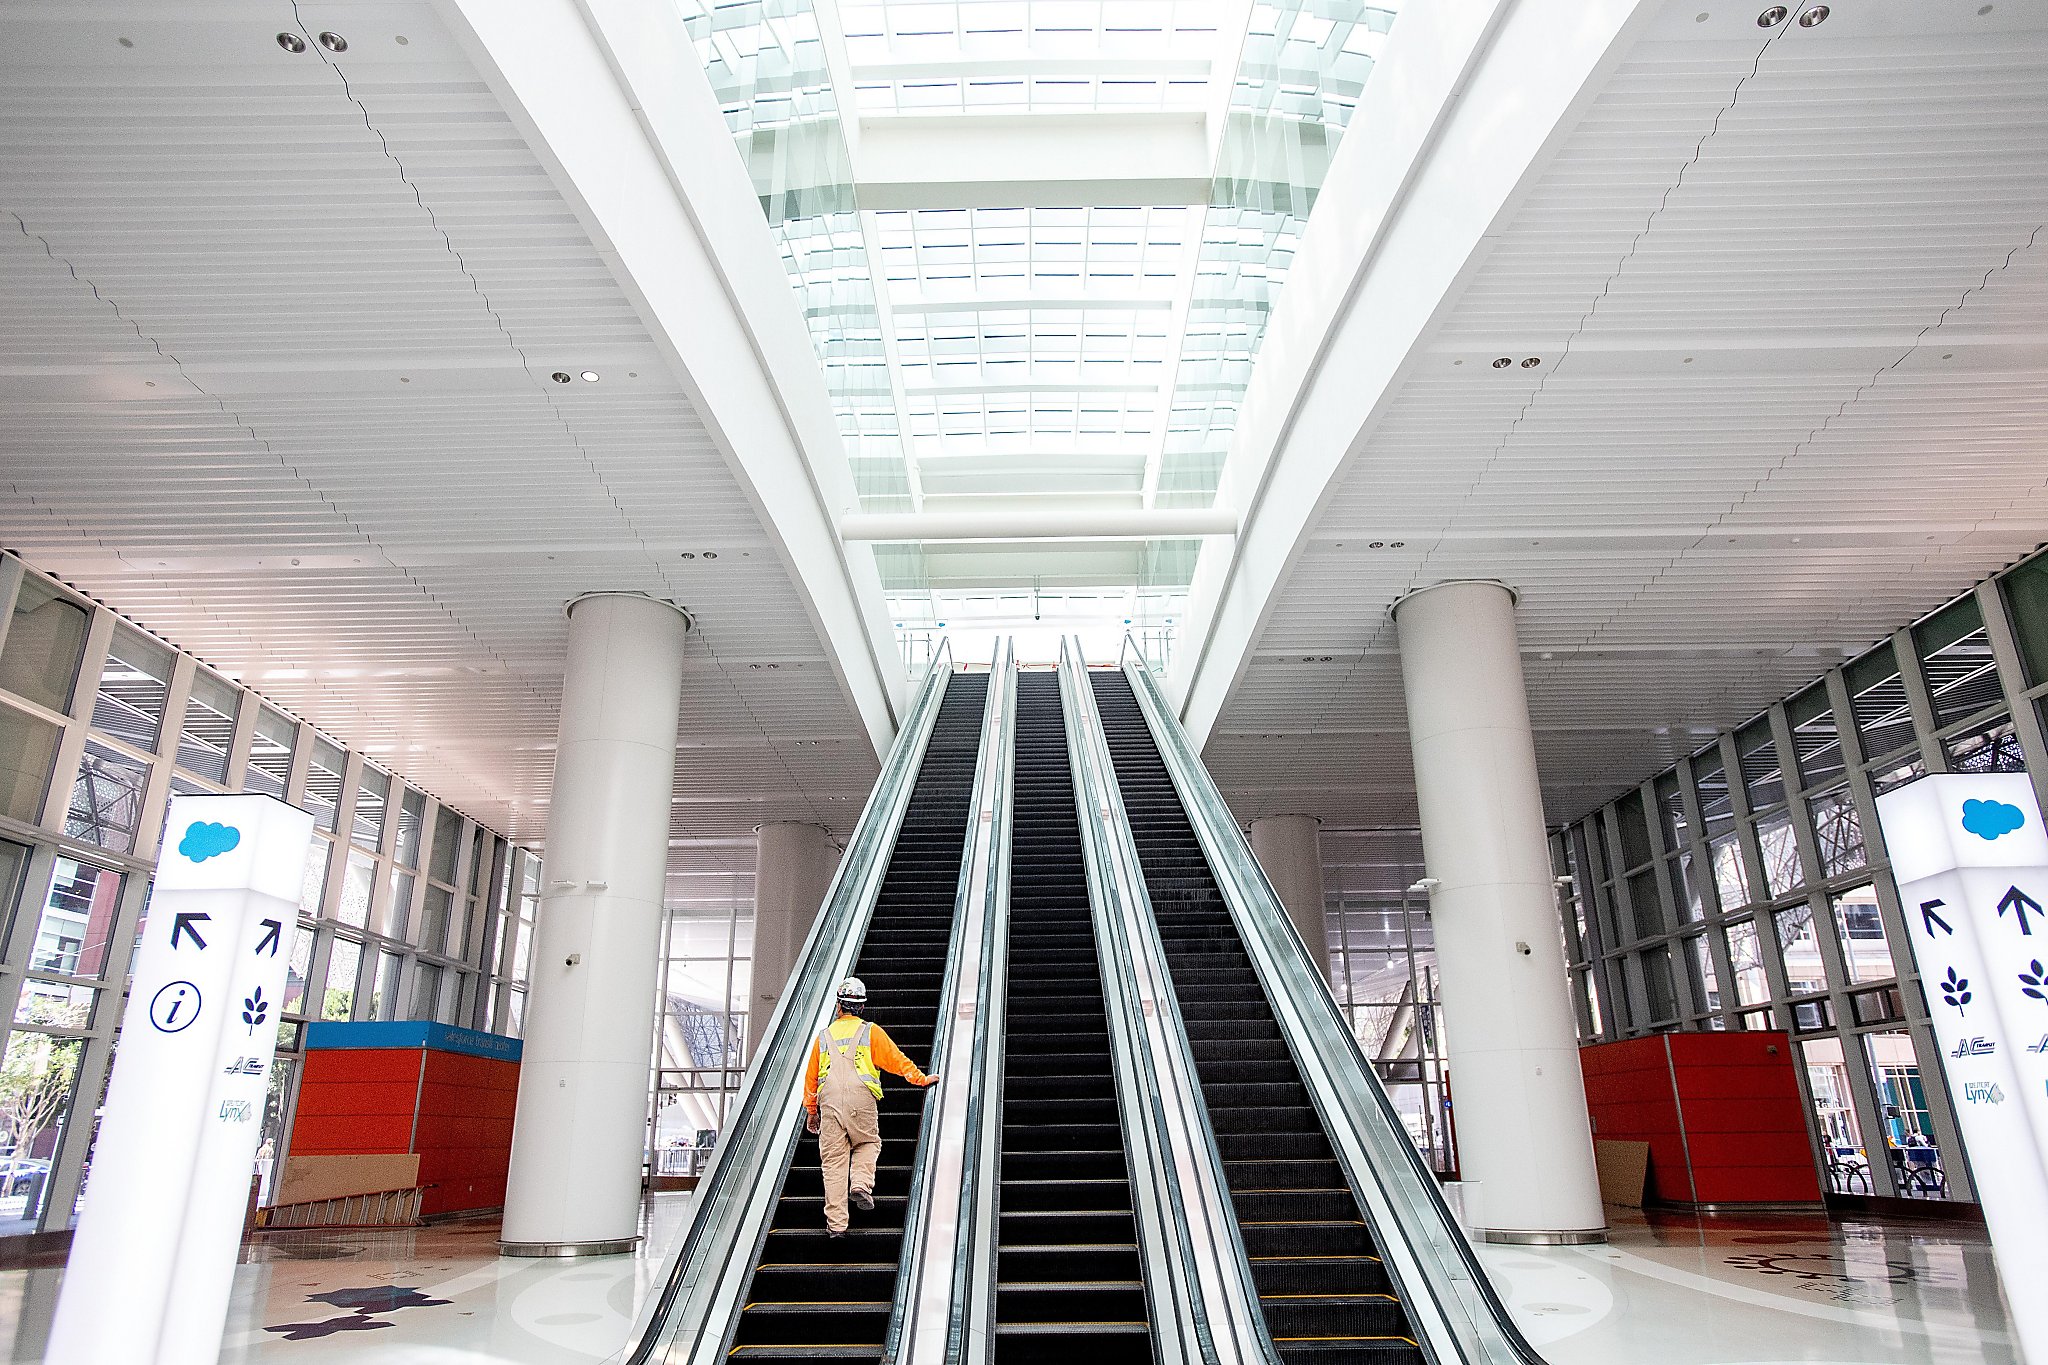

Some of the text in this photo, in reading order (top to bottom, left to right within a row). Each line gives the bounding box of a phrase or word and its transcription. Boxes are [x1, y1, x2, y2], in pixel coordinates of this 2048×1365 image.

[166, 989, 186, 1024] i
[1964, 1082, 1997, 1104] Lynx
[219, 1100, 251, 1122] Lynx
